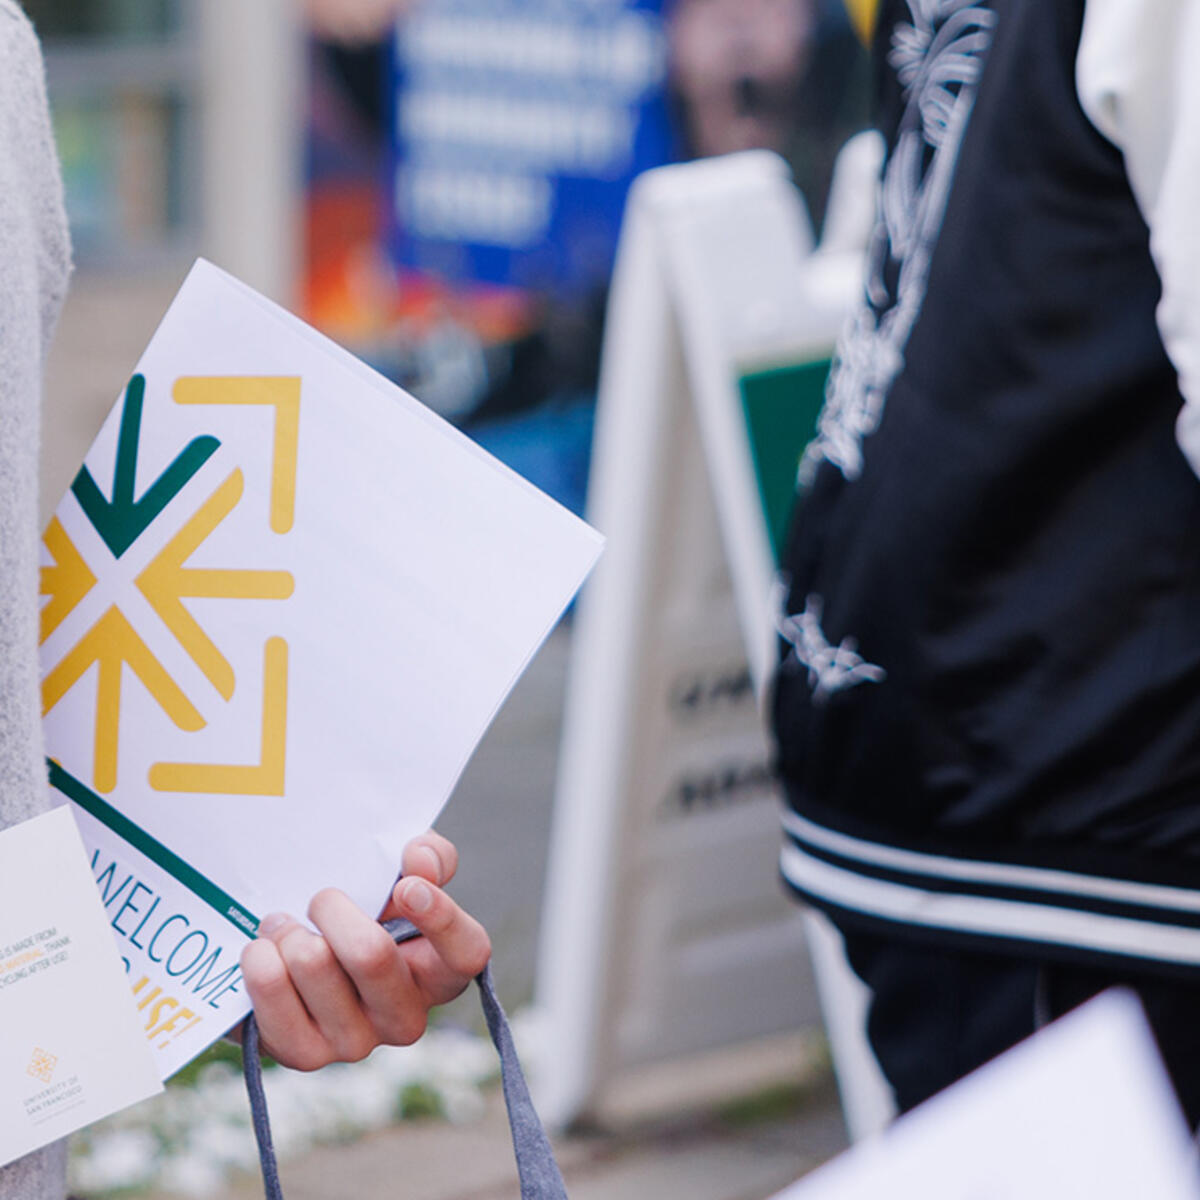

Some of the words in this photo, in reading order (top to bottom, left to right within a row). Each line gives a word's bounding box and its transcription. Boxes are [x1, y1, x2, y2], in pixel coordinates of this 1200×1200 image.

[12, 936, 35, 952] MADE
[34, 926, 57, 942] FROM
[91, 848, 245, 1009] WELCOME
[44, 935, 70, 952] THANK
[28, 957, 50, 973] AFTER
